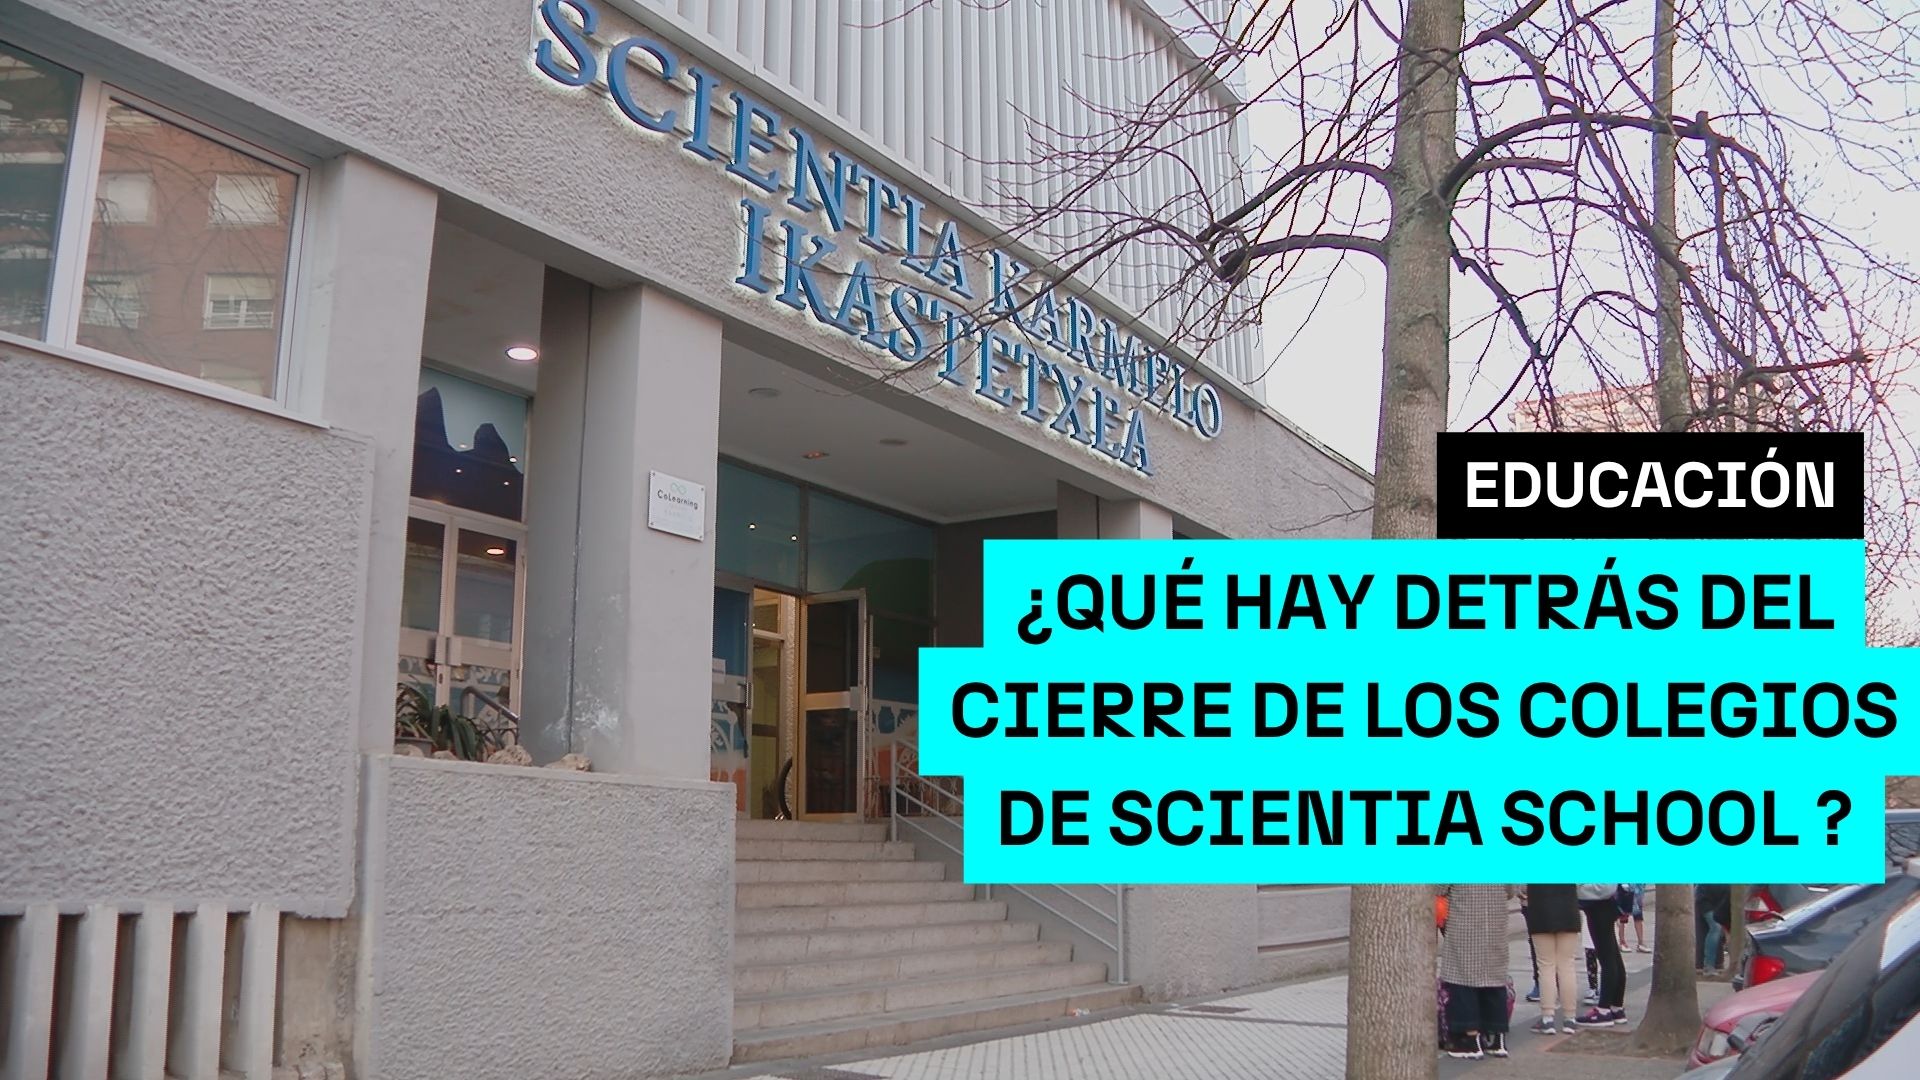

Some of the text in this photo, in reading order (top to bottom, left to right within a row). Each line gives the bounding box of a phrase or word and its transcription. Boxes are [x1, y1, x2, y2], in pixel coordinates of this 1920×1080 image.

[535, 0, 1224, 440] SCIENTIA KARMELO
[735, 199, 1154, 477] IKASTETXEA
